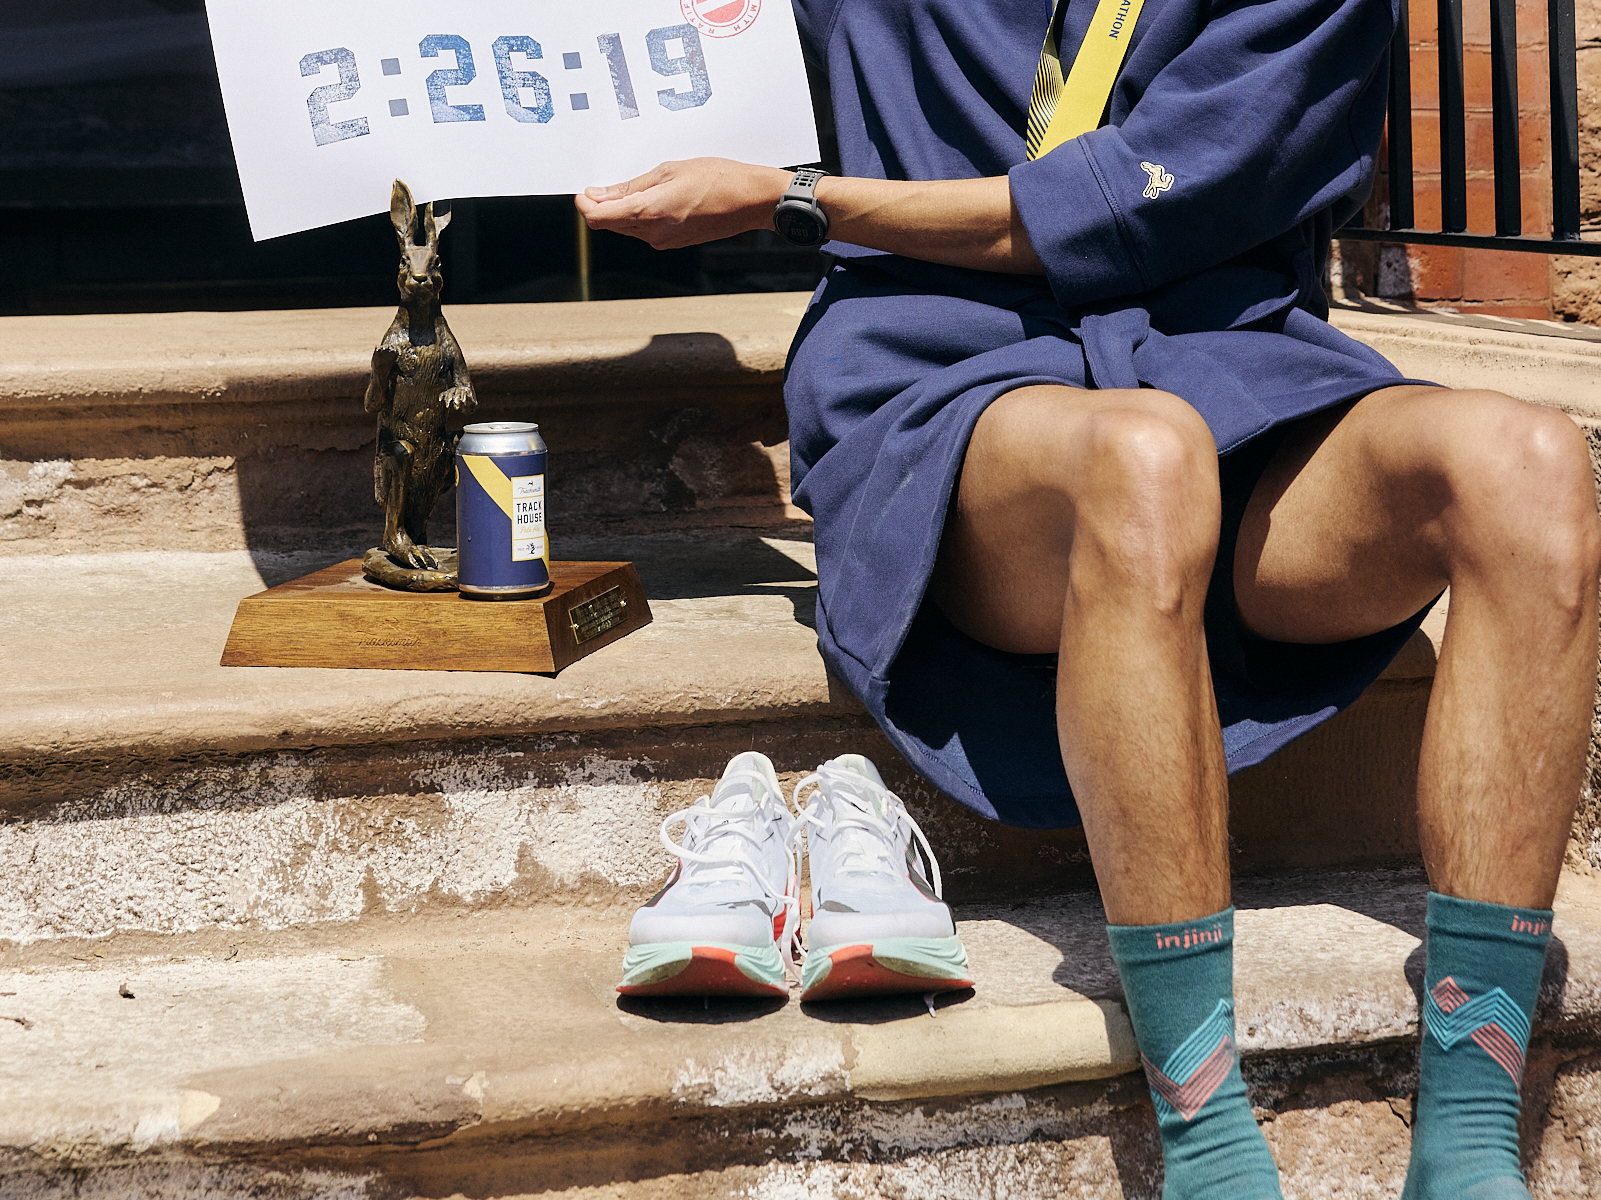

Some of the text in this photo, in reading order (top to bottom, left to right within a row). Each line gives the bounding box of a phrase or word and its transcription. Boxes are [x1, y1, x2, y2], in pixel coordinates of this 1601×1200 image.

[299, 23, 713, 147] 2:26:19
[516, 501, 542, 513] TRACK
[517, 512, 542, 525] HOUSE
[1155, 923, 1223, 950] injinji
